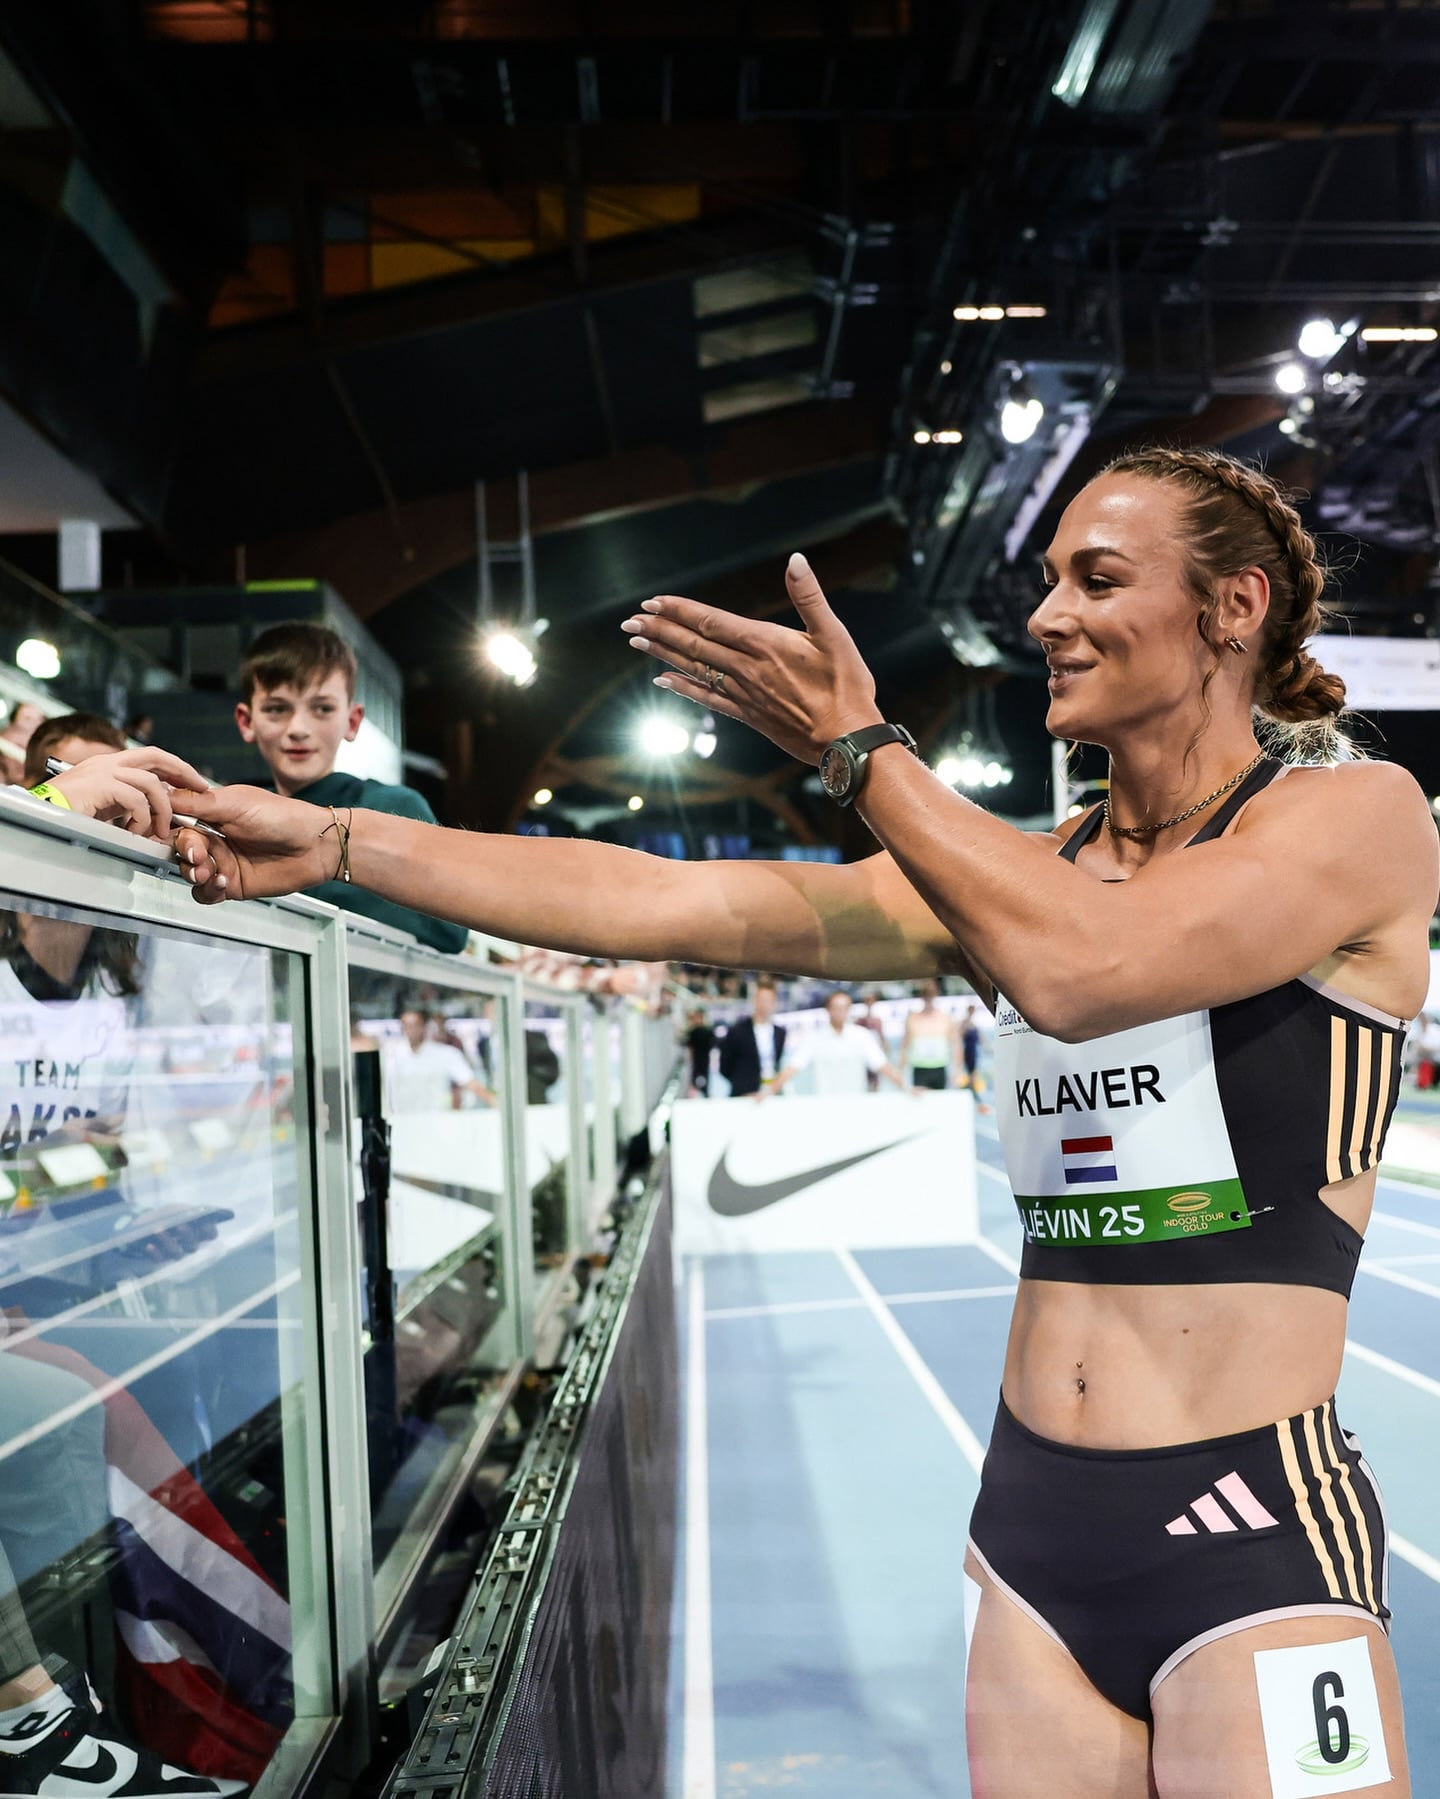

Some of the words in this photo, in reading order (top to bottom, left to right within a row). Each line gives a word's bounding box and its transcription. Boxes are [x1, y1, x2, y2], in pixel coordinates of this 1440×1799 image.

[14, 1059, 81, 1090] TEAM
[1015, 1064, 1166, 1117] KLAVER
[1021, 1201, 1092, 1239] LIÉVIN
[1098, 1204, 1145, 1237] 25
[1163, 1216, 1198, 1227] INDOOR
[1200, 1212, 1224, 1222] TOUR
[1182, 1222, 1208, 1233] GOLD
[1312, 1671, 1350, 1764] 6
